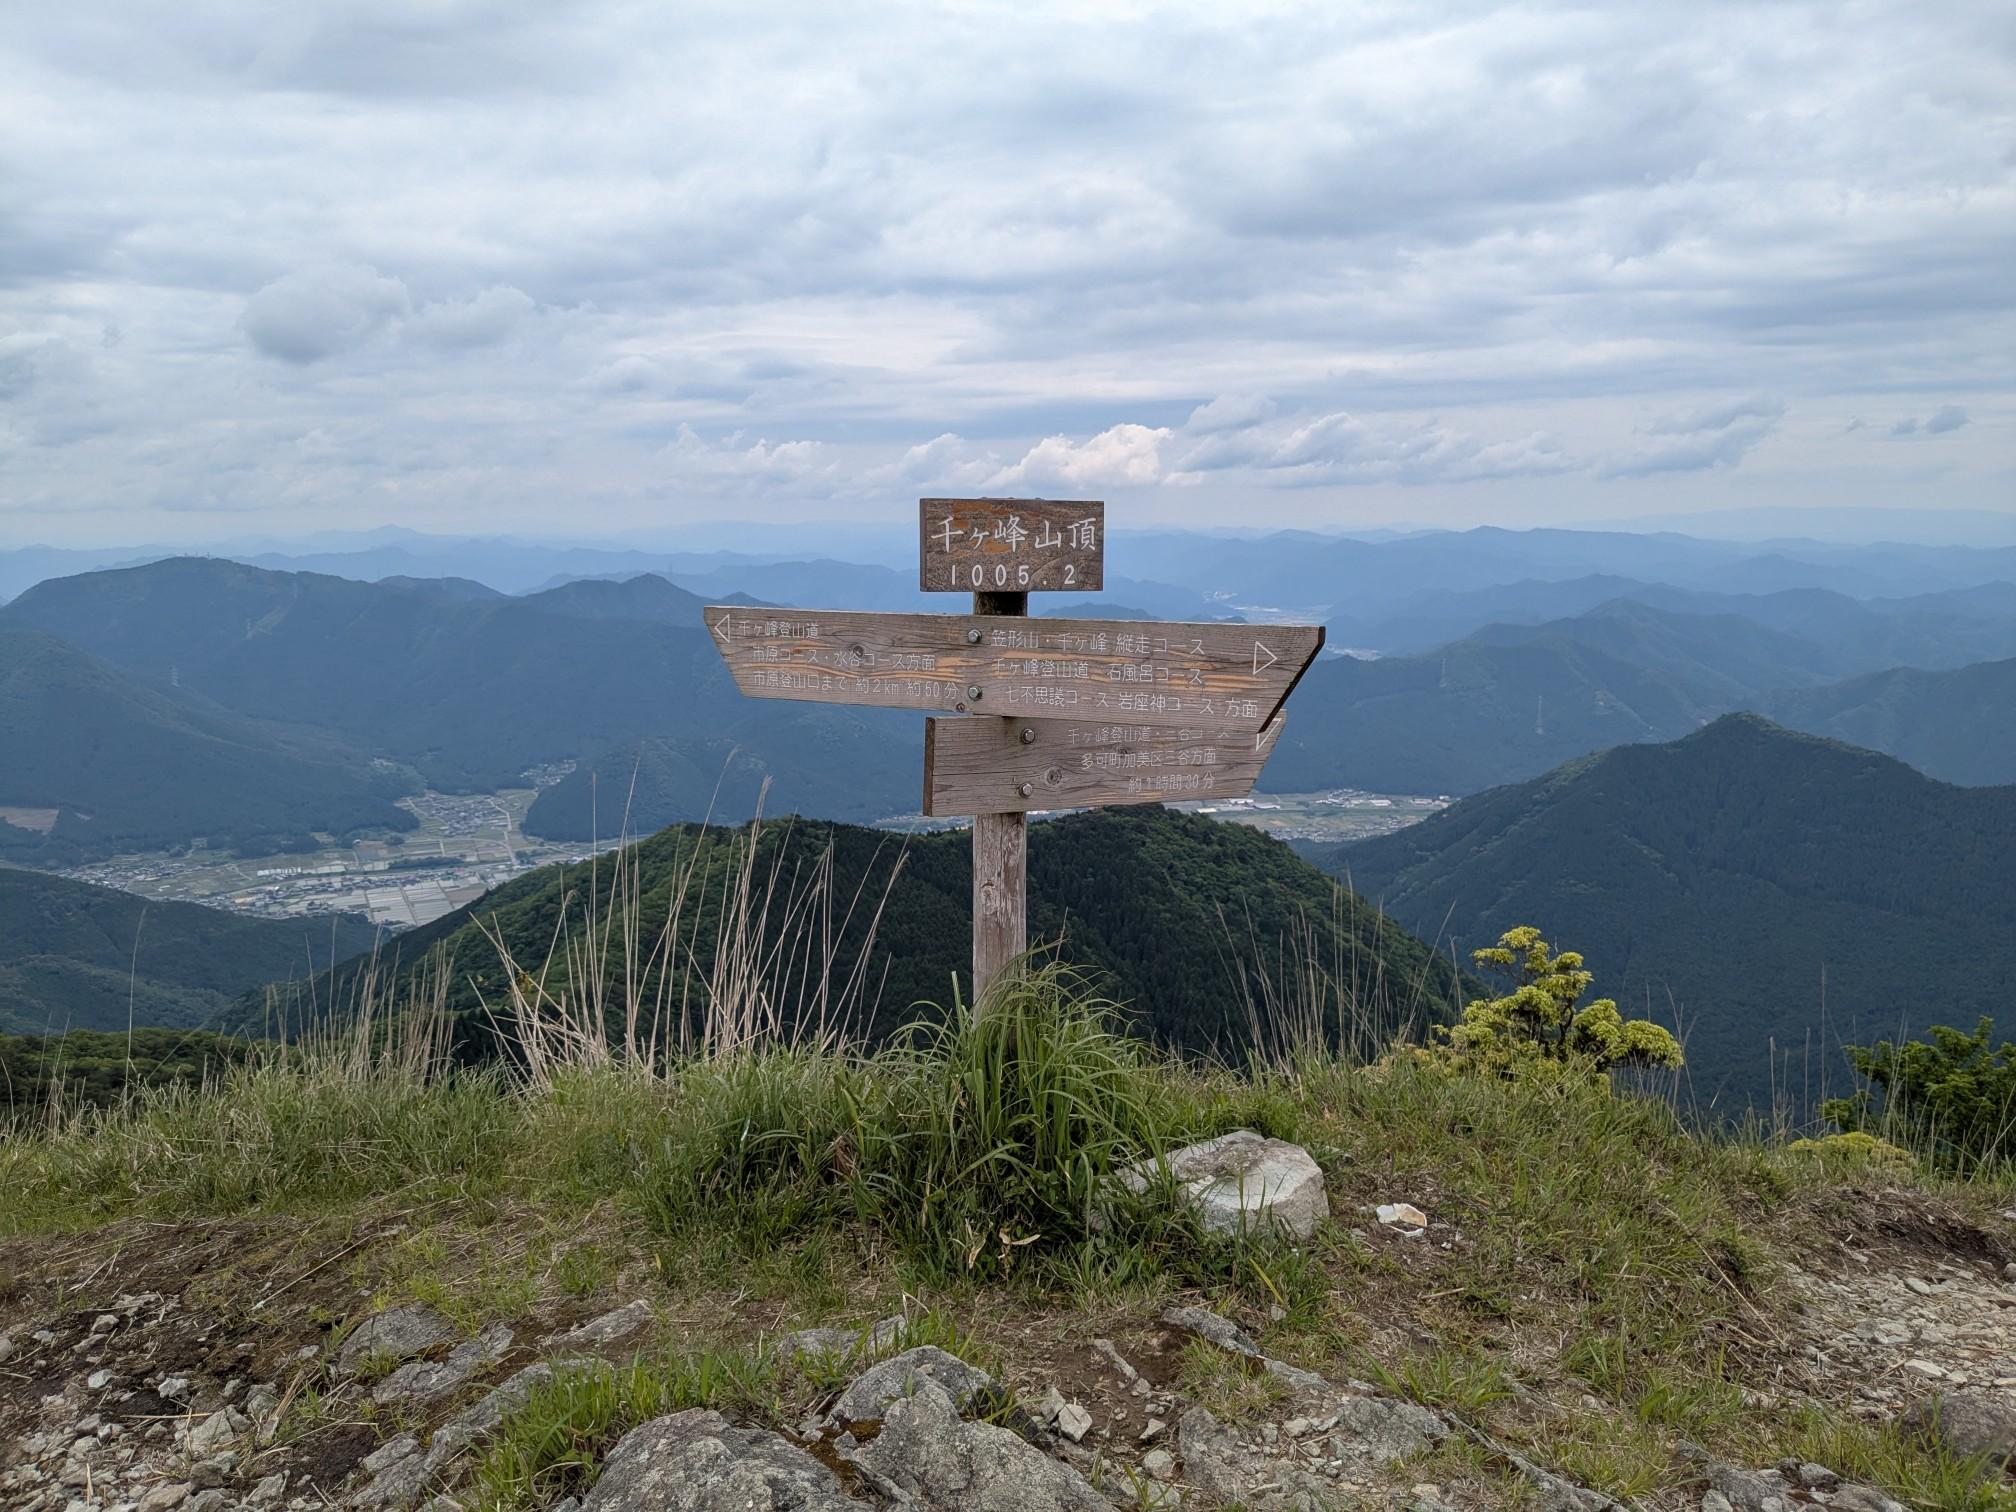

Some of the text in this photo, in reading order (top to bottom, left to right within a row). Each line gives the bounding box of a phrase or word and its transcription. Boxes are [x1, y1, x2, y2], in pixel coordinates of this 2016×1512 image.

[931, 514, 1097, 553] 千ヶ峰山頂
[951, 564, 1077, 587] 1005.2
[738, 621, 820, 640] 千ヶ峰登山道
